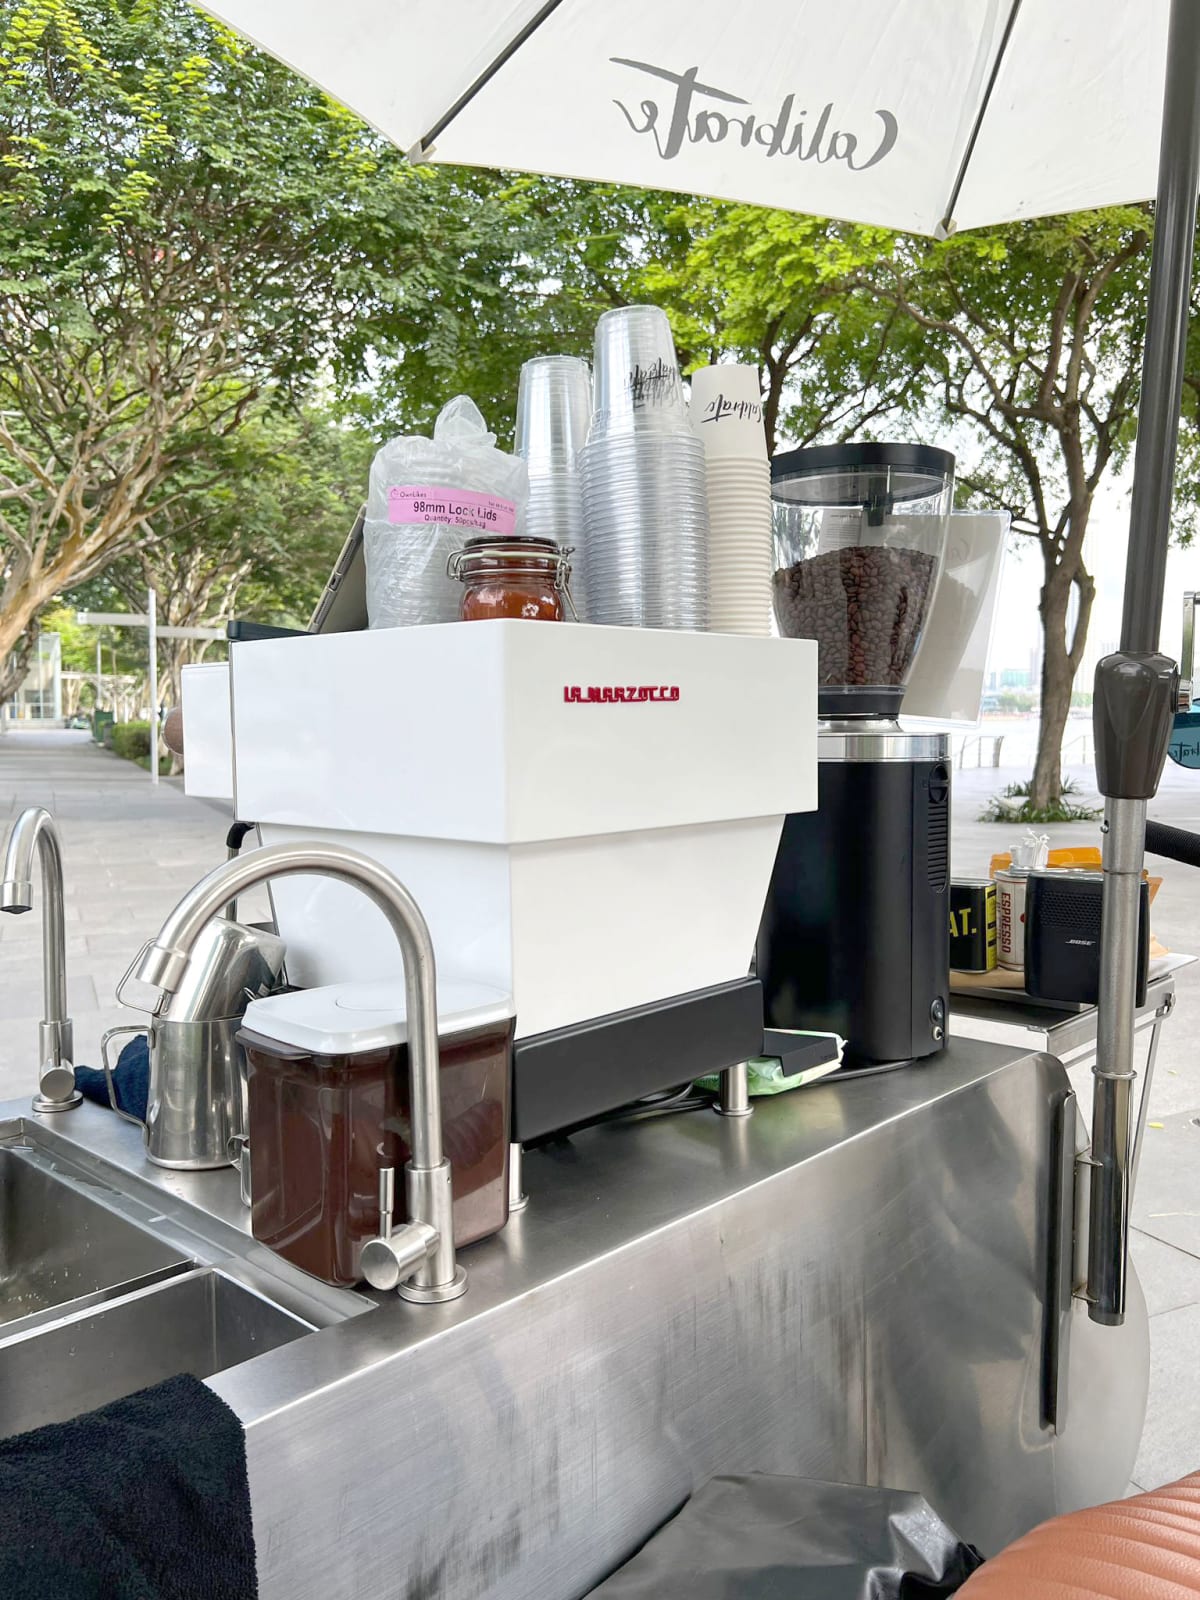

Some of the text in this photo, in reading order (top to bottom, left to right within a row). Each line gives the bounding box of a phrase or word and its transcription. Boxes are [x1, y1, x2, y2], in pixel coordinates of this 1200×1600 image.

[413, 501, 446, 513] 98mm
[448, 503, 475, 517] Lock
[477, 507, 497, 521] Lids
[563, 686, 681, 703] LA MARZOCCO
[1001, 892, 1012, 954] ESPRESSO
[1064, 938, 1097, 947] BOSE
